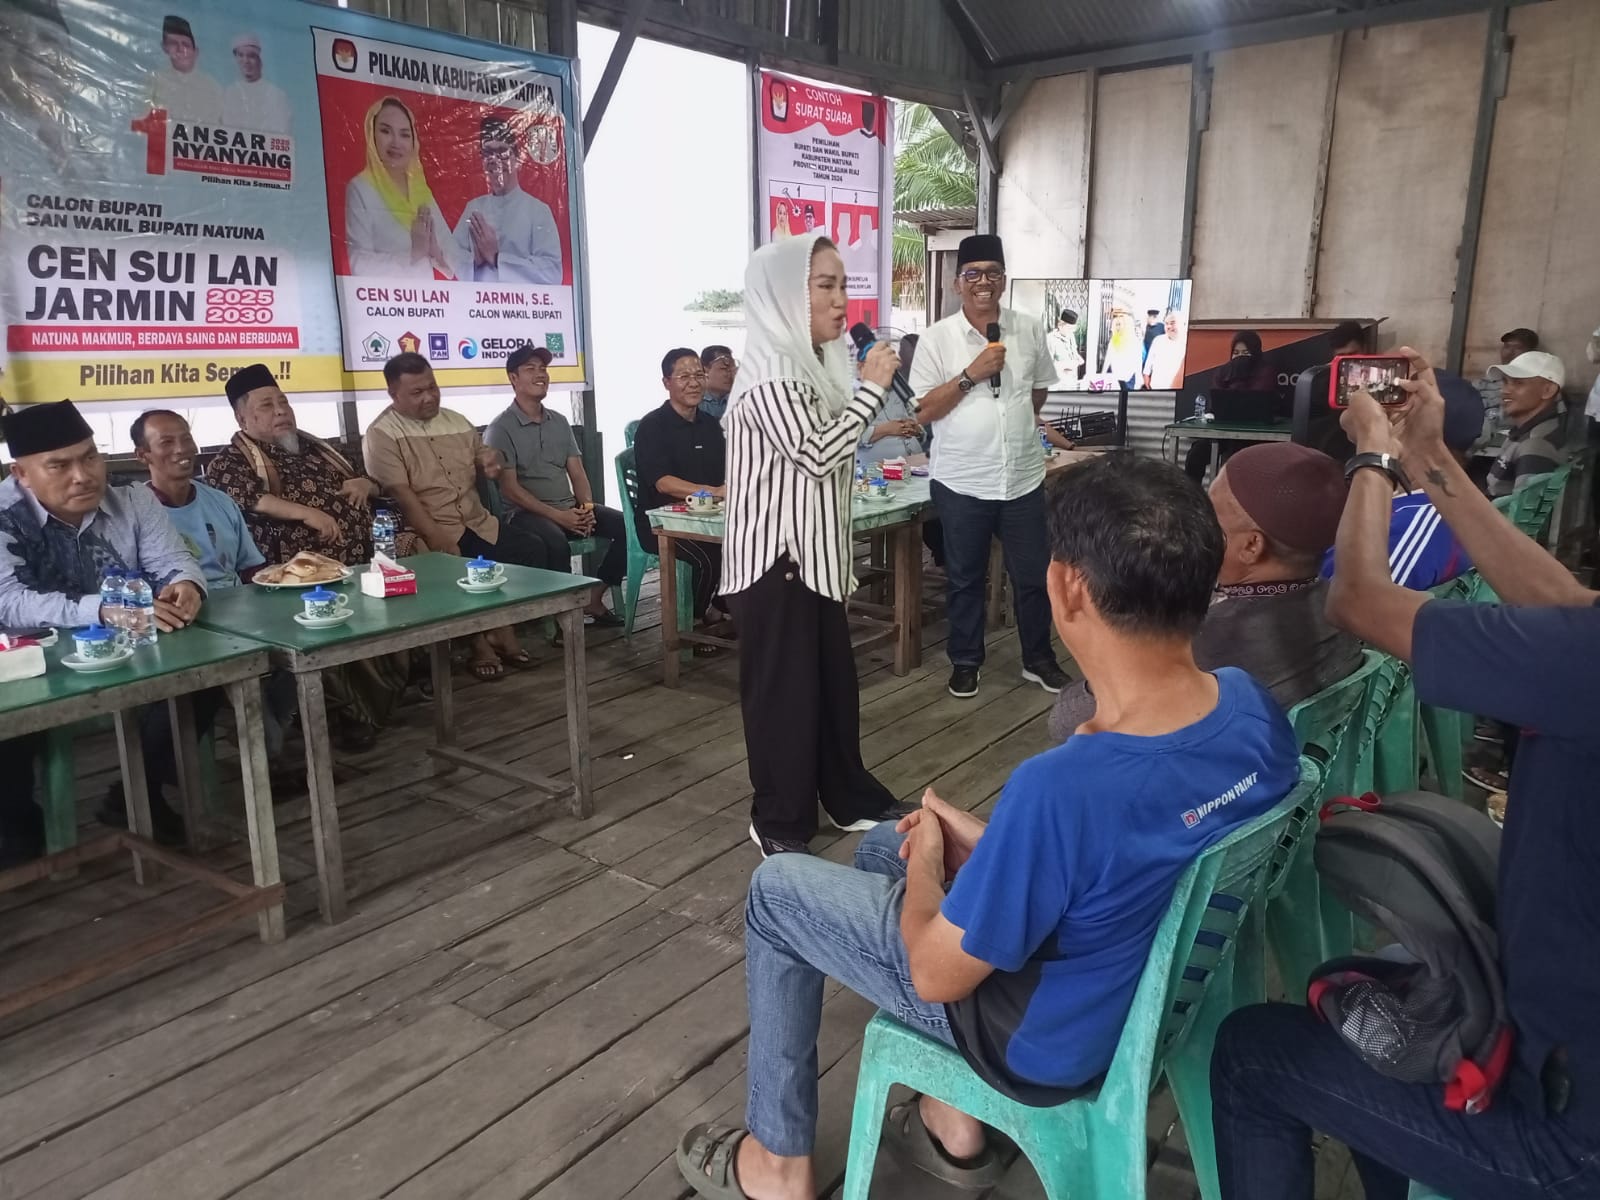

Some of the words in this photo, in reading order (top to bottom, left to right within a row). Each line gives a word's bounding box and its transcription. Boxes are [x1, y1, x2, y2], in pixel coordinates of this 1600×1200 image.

[369, 51, 430, 84] PILKADA
[805, 87, 843, 106] CONTOH
[795, 102, 824, 120] SURAT
[825, 108, 853, 125] SUARA
[131, 108, 168, 176] 1
[172, 123, 266, 150] ANSAR
[173, 141, 291, 169] NYANYANG
[202, 175, 232, 185] Pilihan
[233, 178, 251, 187] Kita
[26, 194, 94, 213] CALON
[99, 200, 163, 217] BUPATI
[73, 215, 133, 232] WAKIL
[138, 220, 199, 237] BUPATI
[202, 224, 265, 241] NATUNA
[27, 244, 116, 281] CEN
[128, 250, 196, 284] SUI
[207, 254, 278, 287] LAN
[25, 286, 196, 322] JARMIN
[206, 288, 274, 306] 2025
[356, 287, 389, 302] CEN
[393, 289, 418, 302] SUI
[422, 290, 450, 304] LAN
[475, 291, 529, 306] JARMIN,
[531, 293, 554, 306] S.E.
[205, 307, 273, 324] 2030
[366, 306, 405, 317] CALON
[407, 307, 445, 318] BUPATI
[469, 309, 500, 319] CALON
[502, 310, 530, 320] WAKIL
[532, 311, 562, 320] BUPATI
[31, 331, 79, 346] NATUNA
[82, 332, 136, 348] MAKMUR,
[137, 332, 184, 345] BERDAYA
[185, 332, 215, 345] SAING
[217, 332, 237, 345] DAN
[239, 332, 294, 345] BERBUDAYA
[80, 364, 154, 386] Pilihan
[160, 363, 200, 384] Kita
[1196, 789, 1236, 819] NIPPON
[1233, 771, 1258, 797] PAINT
